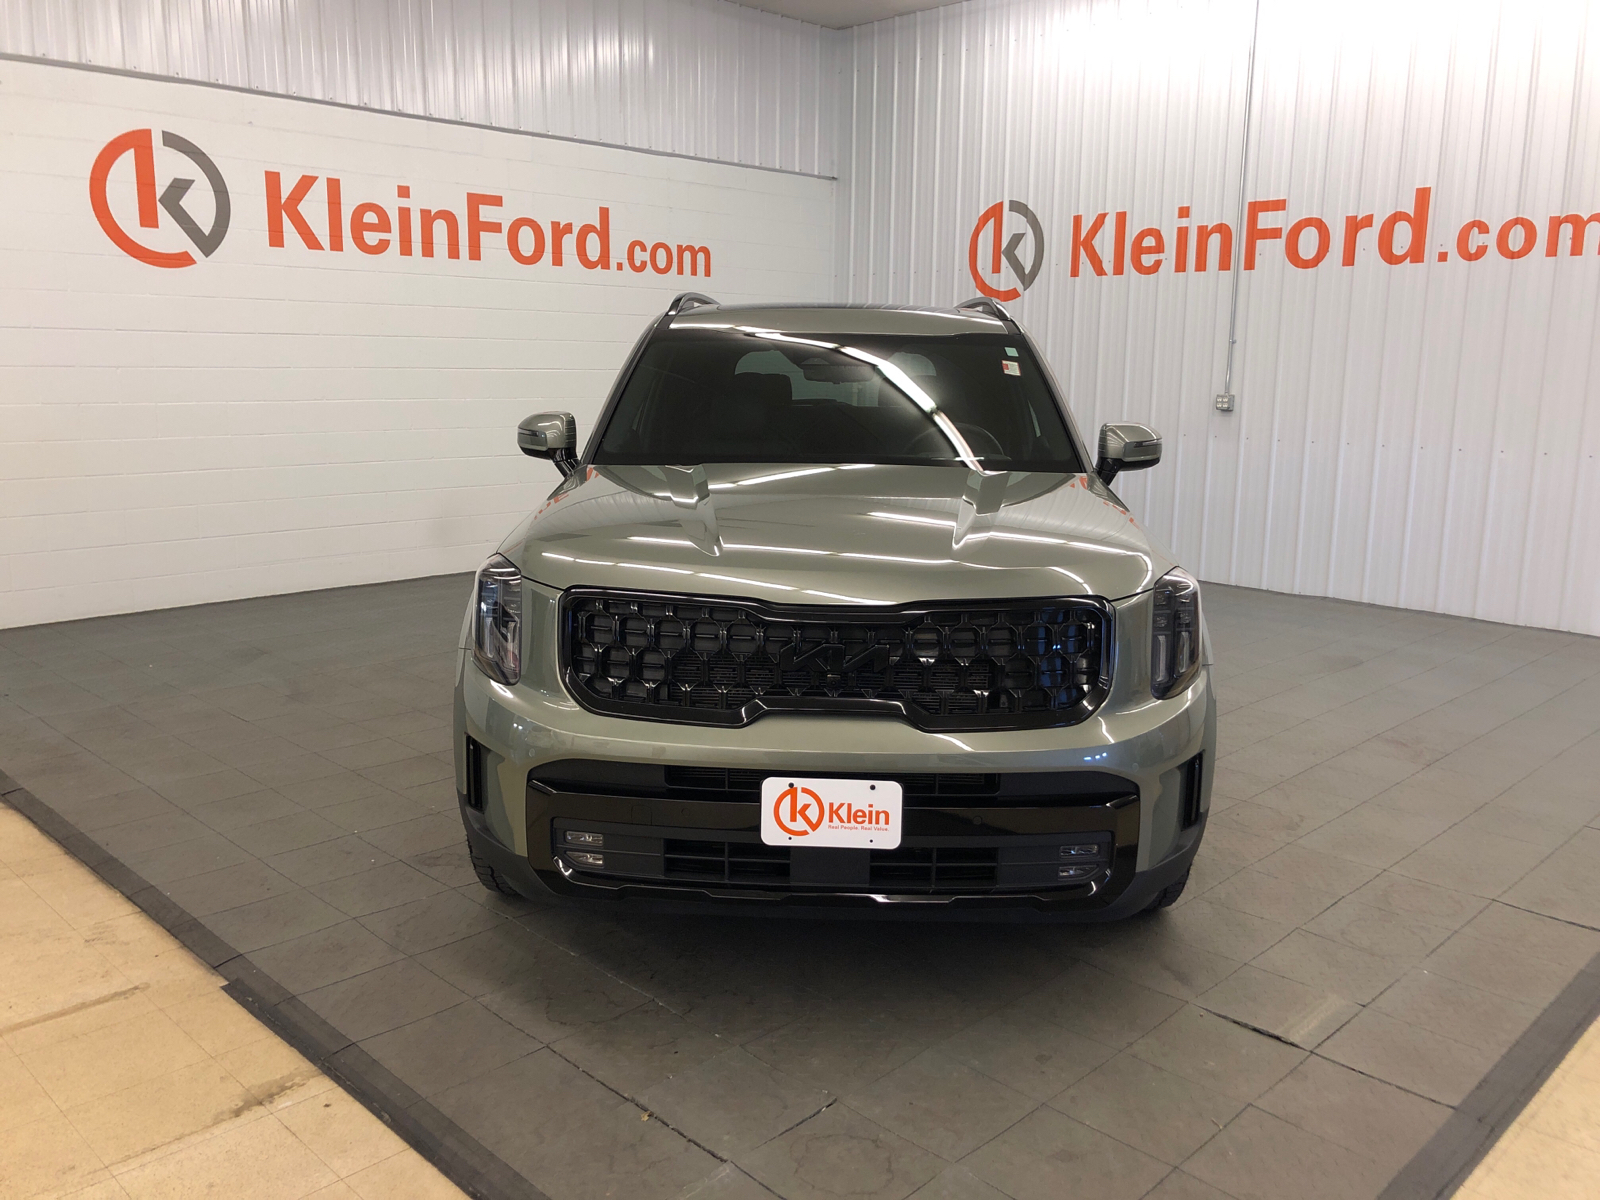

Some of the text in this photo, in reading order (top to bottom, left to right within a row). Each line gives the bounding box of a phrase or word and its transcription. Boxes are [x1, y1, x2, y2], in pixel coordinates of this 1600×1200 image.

[264, 170, 711, 278] KleinFord.com
[1070, 187, 1600, 278] KleinFord.com
[828, 802, 889, 825] Klein
